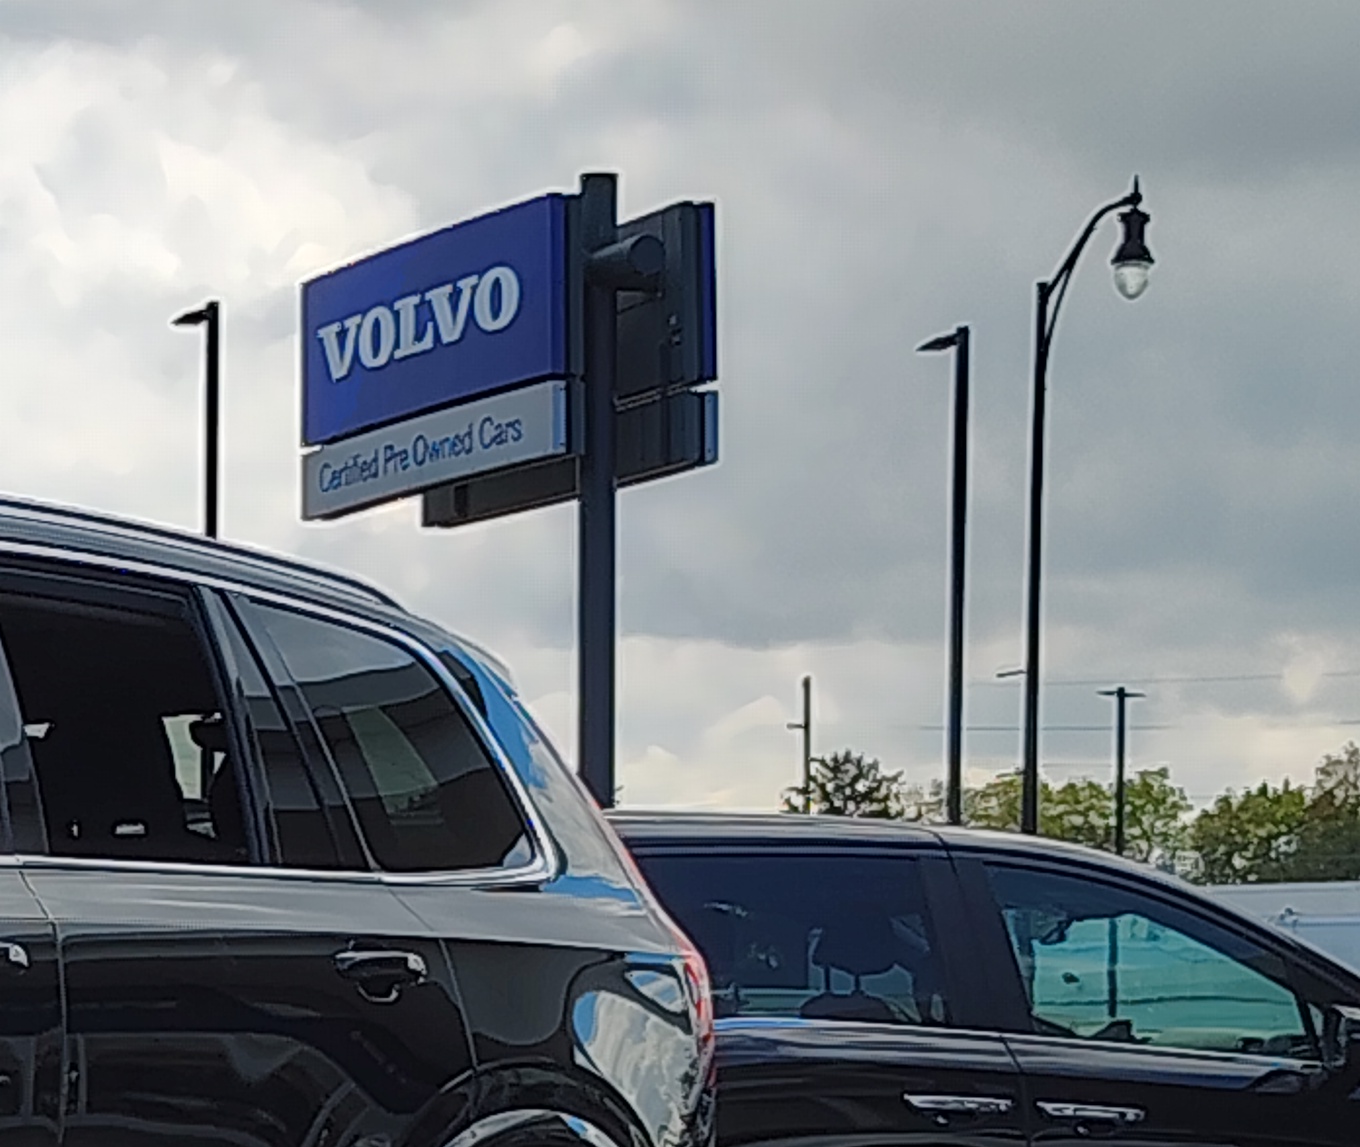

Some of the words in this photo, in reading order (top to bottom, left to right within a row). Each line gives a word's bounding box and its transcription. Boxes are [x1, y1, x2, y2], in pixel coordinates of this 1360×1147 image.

[317, 266, 520, 383] VOLVO
[319, 449, 379, 493] Certified
[383, 444, 410, 477] Pre
[412, 422, 474, 467] Owned
[478, 416, 523, 450] Cars
